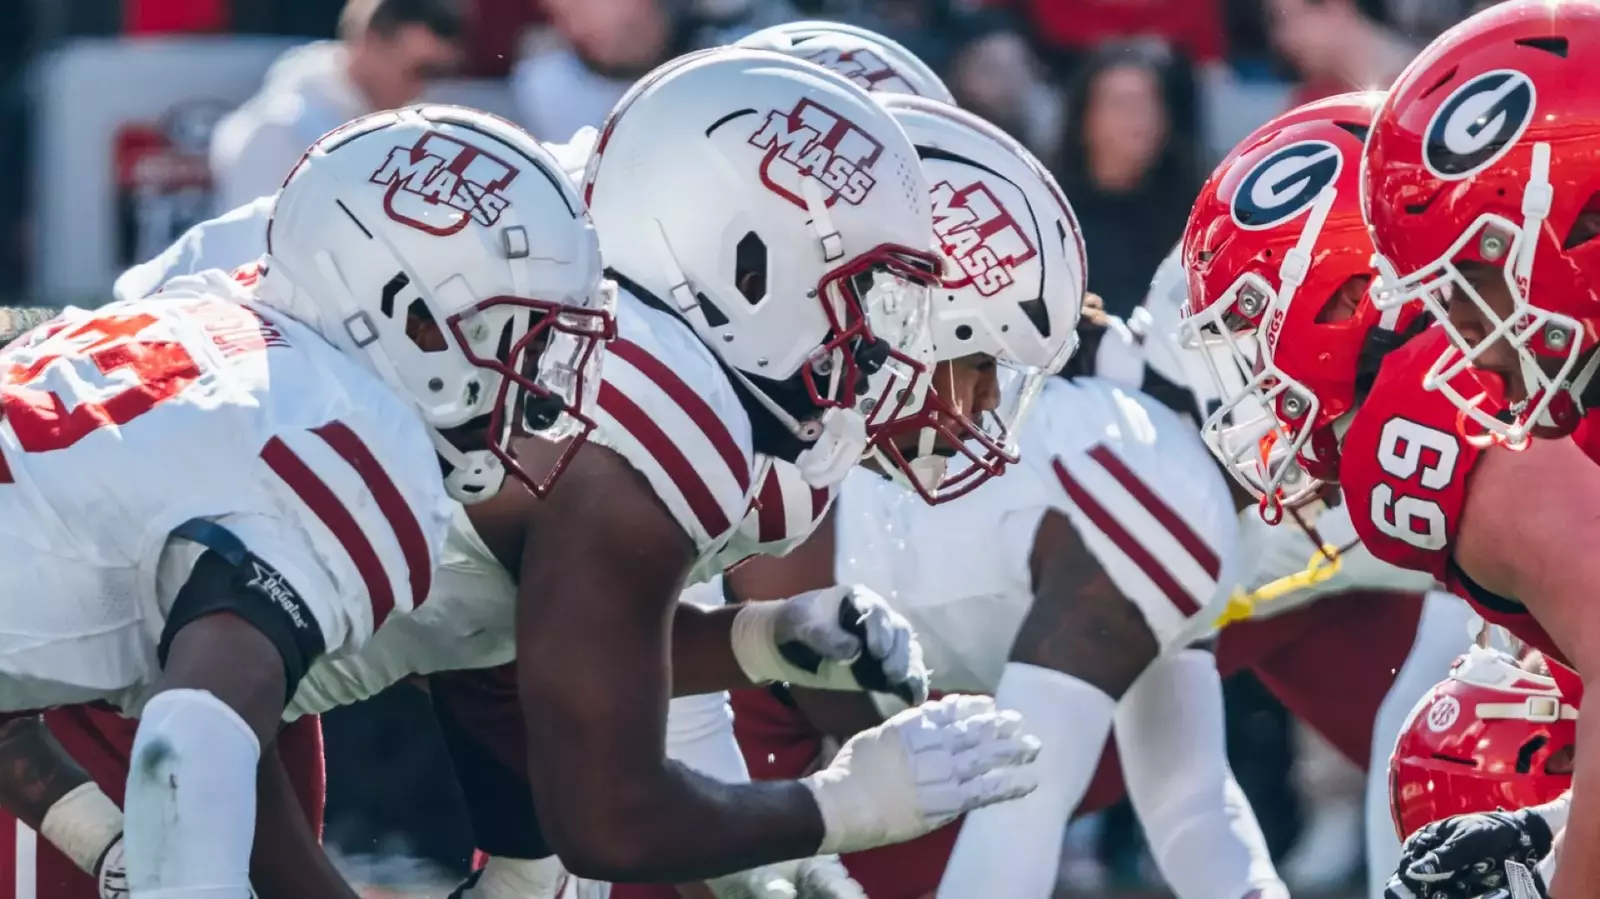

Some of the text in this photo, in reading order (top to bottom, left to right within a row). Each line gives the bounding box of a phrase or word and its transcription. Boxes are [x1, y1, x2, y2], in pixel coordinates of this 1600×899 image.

[369, 145, 513, 227] MASS
[747, 109, 877, 206] MASS
[929, 180, 1016, 297] MASS
[1268, 308, 1284, 346] OGS
[1370, 415, 1461, 552] 69
[263, 577, 303, 629] Douglas
